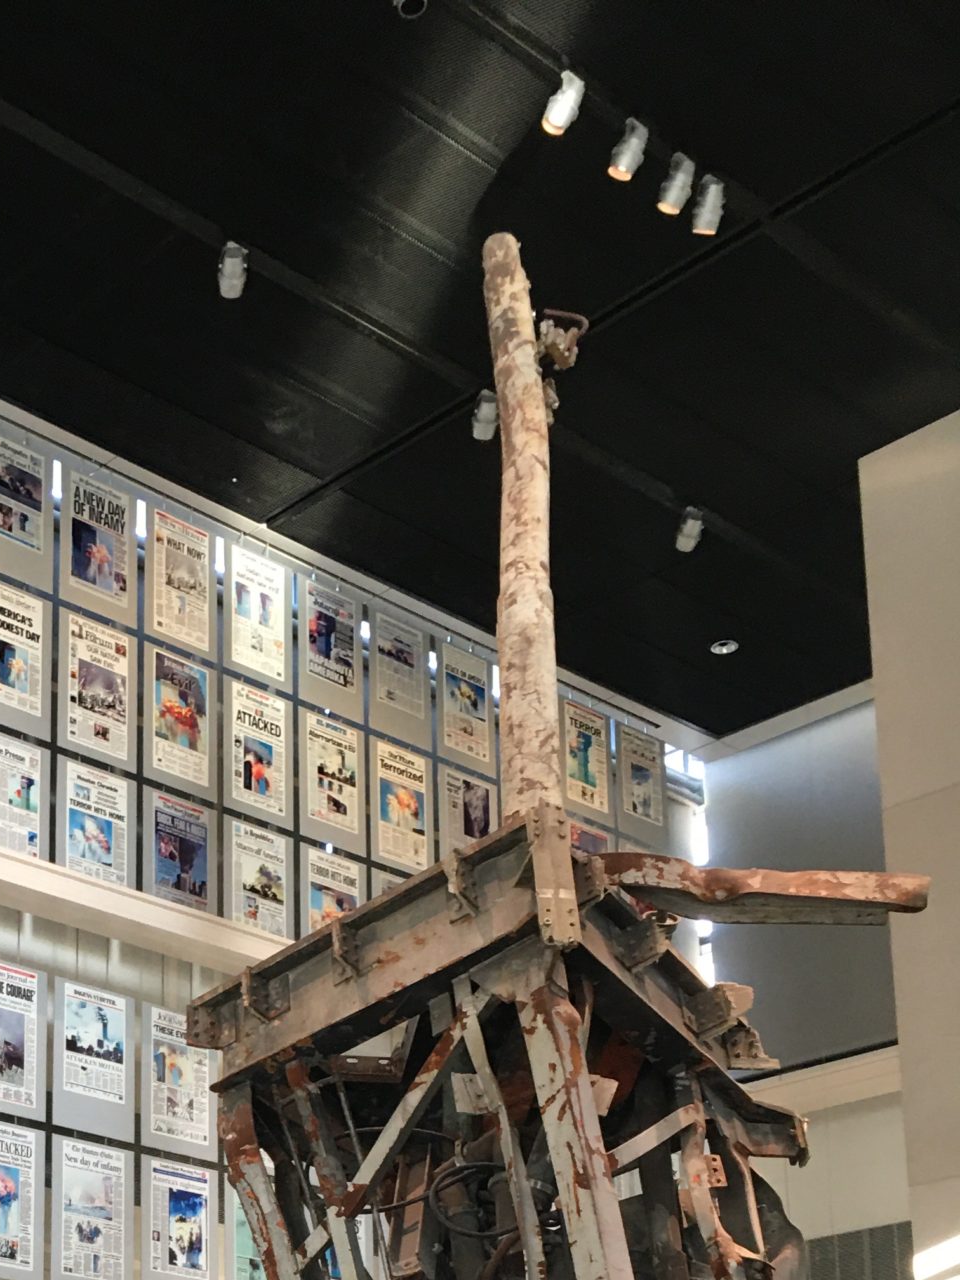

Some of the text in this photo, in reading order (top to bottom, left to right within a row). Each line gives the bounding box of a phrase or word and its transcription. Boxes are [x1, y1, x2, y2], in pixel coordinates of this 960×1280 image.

[83, 489, 126, 520] NEW DAY
[89, 506, 126, 535] INFAMY
[166, 537, 185, 554] WHAT
[25, 630, 41, 644] DAY
[236, 709, 282, 738] ATTACKED
[569, 716, 602, 738] TERROR
[380, 758, 424, 784] Terrorized
[69, 798, 126, 823] TERROR HOME
[64, 1153, 122, 1178] New day of infamy
